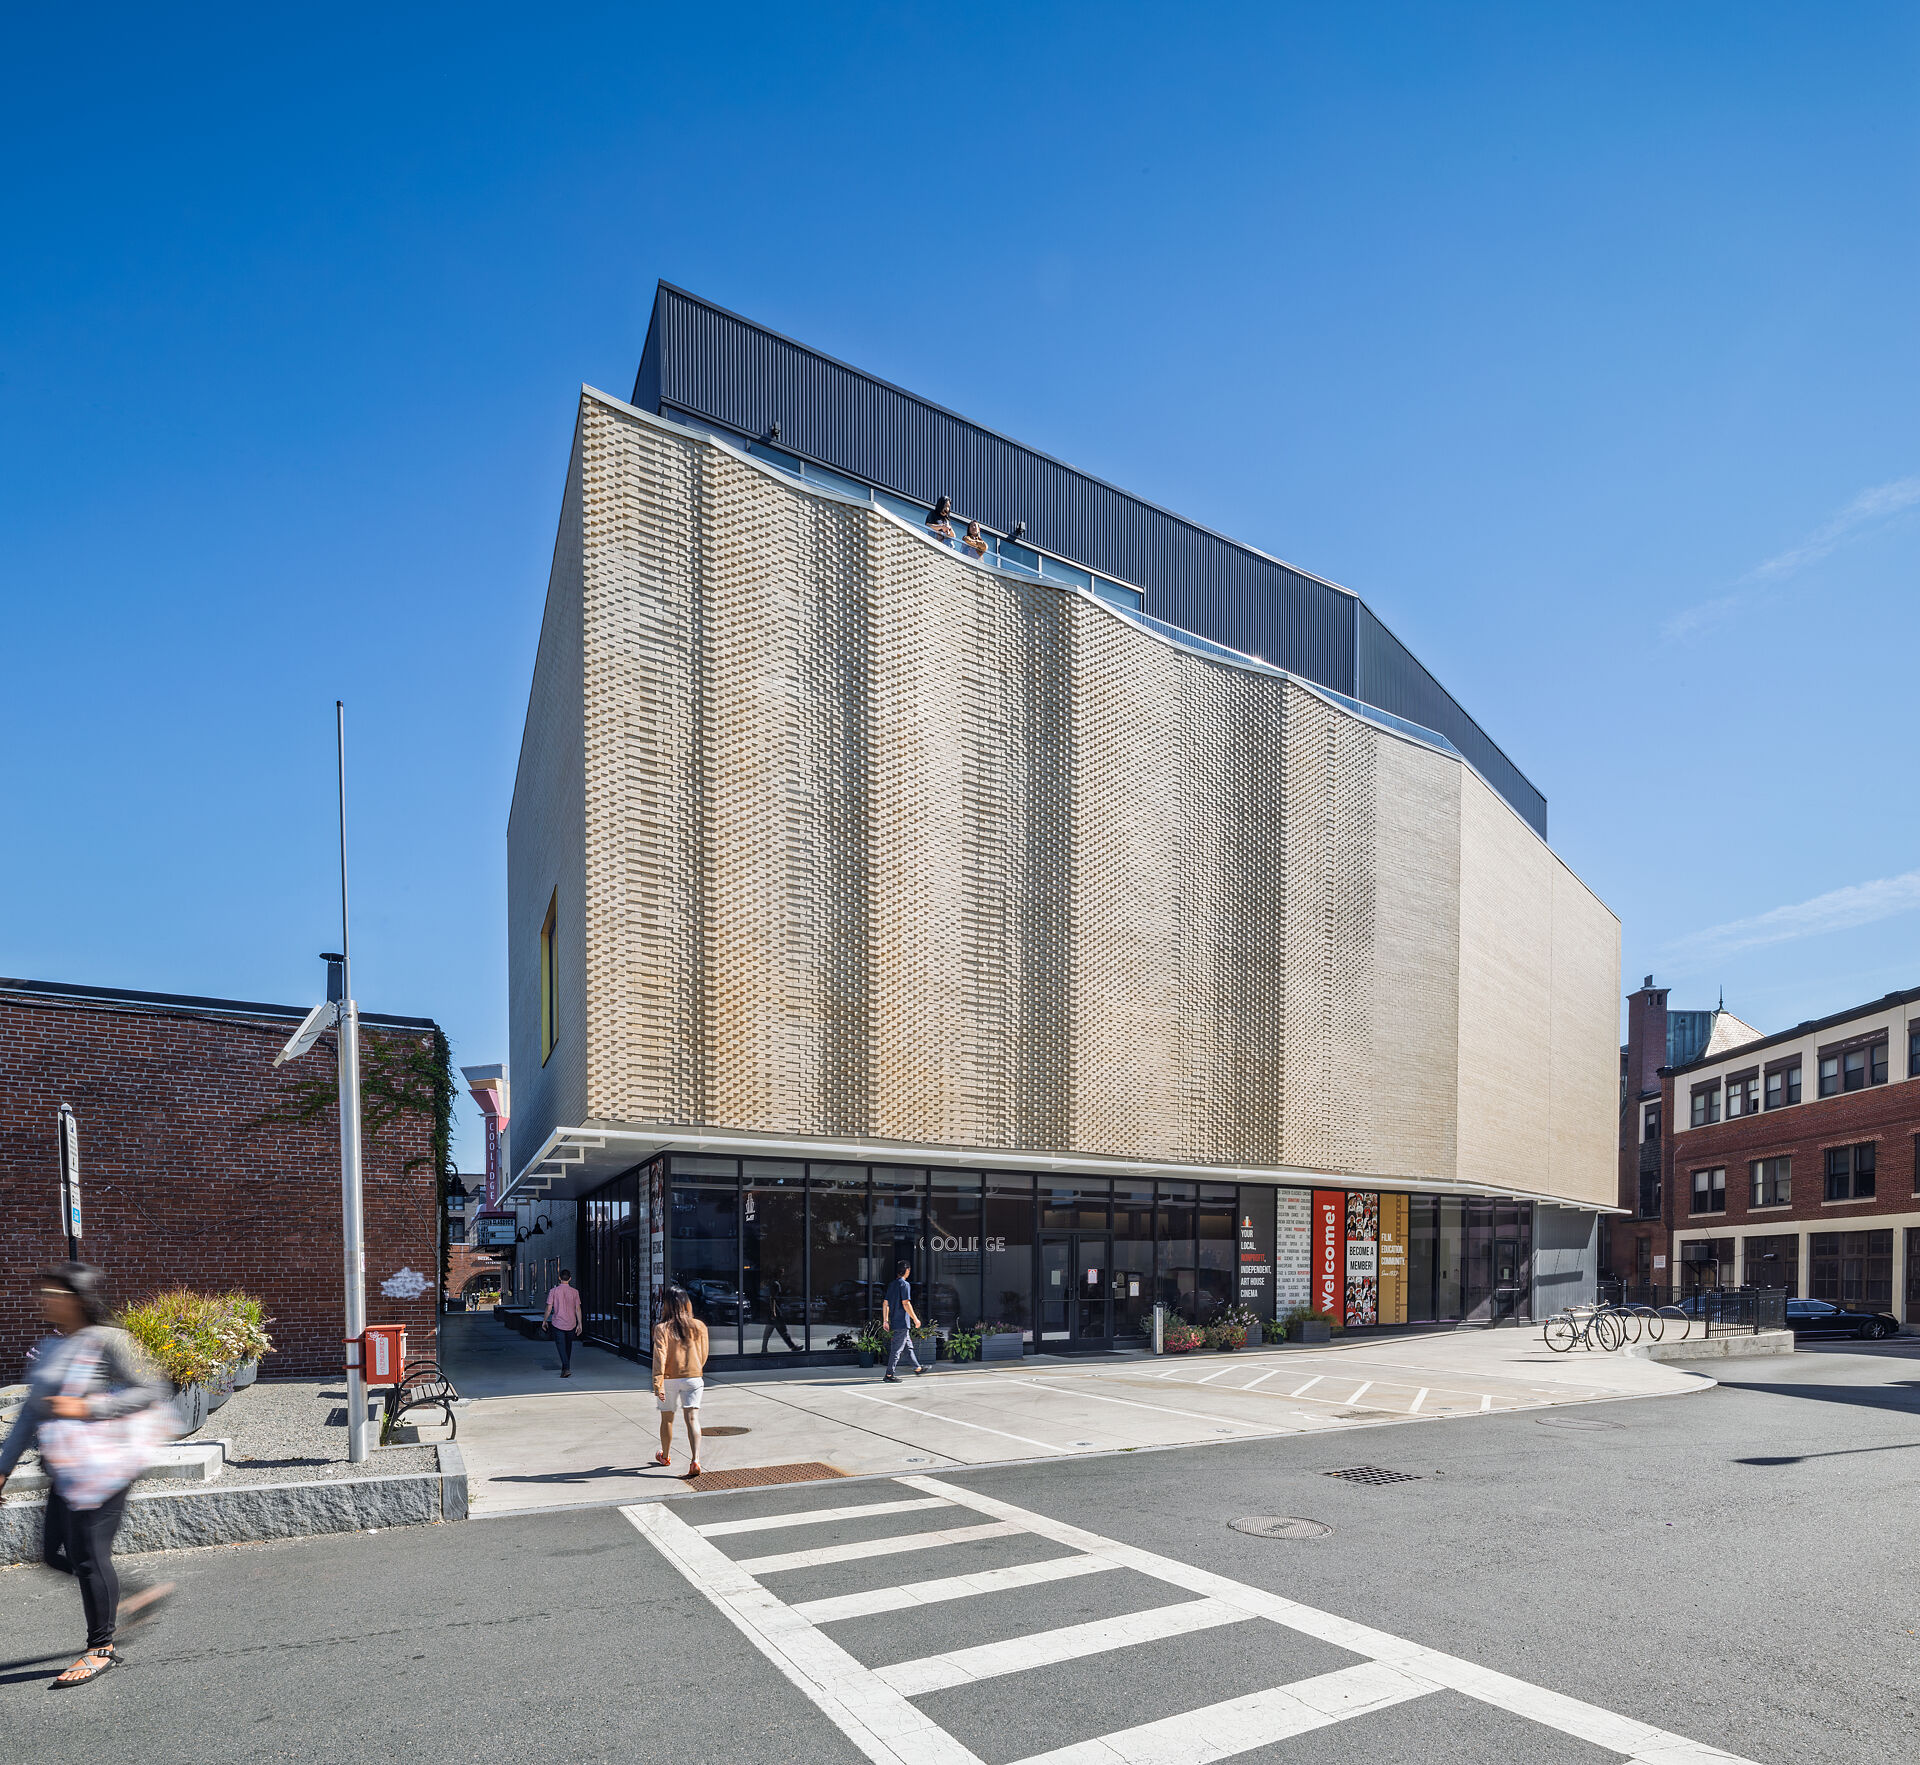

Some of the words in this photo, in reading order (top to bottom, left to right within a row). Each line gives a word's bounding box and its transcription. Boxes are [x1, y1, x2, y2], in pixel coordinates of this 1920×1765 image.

[1240, 1229, 1254, 1238] YOUR
[1240, 1241, 1257, 1251] LOCAL,
[1349, 1246, 1370, 1256] BECOME
[1370, 1247, 1374, 1256] A
[1321, 1204, 1336, 1313] Welcome!
[1240, 1265, 1272, 1275] INDEPENDENT,
[1349, 1260, 1374, 1271] MEMBER!
[1240, 1277, 1250, 1286] ART
[1250, 1277, 1265, 1286] HOUSE
[1240, 1289, 1258, 1298] CINEMA
